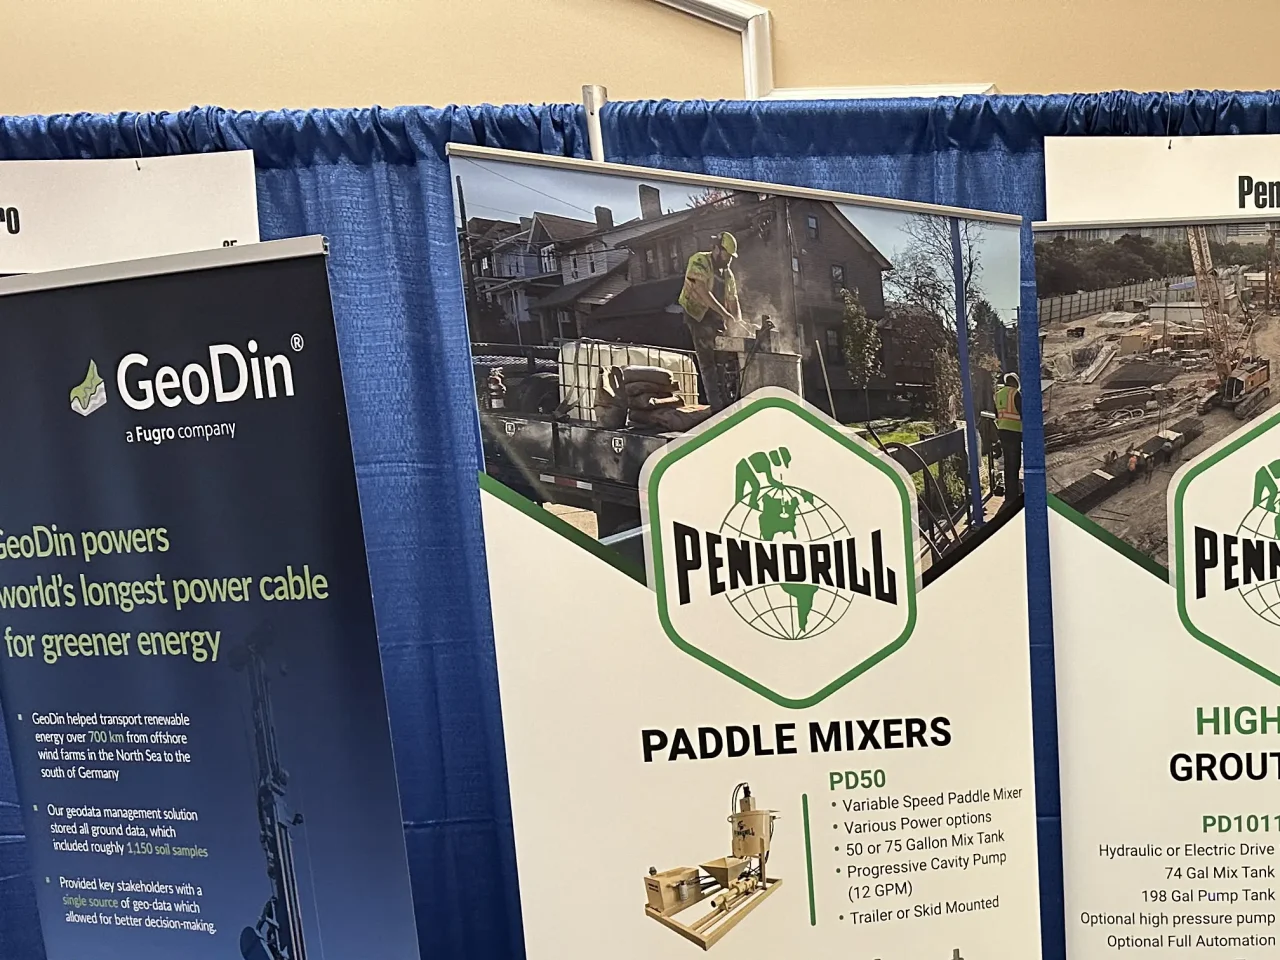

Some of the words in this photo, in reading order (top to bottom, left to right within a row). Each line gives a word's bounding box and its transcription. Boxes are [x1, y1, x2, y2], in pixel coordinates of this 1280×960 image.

[126, 431, 134, 443] a
[135, 426, 175, 445] Fugro
[177, 422, 236, 442] company
[81, 527, 170, 563] powers
[672, 520, 898, 606] PENNDRILL
[0, 573, 76, 609] world's
[79, 573, 168, 613] longest
[172, 576, 253, 611] power
[259, 564, 329, 601] cable
[4, 626, 36, 658] for
[41, 632, 131, 664] greener
[137, 630, 221, 663] energy
[31, 712, 66, 725] GeoDin
[66, 712, 98, 728] helped
[99, 713, 143, 728] transport
[143, 712, 190, 726] renewable
[35, 733, 65, 746] energy
[66, 733, 87, 743] over
[87, 730, 107, 743] 700
[108, 730, 125, 743] km
[126, 730, 149, 744] from
[149, 730, 188, 745] offshore
[641, 722, 798, 763] PADDLE
[809, 716, 952, 753] MIXERS
[829, 769, 887, 791] PD50
[842, 795, 899, 812] Variable
[903, 792, 944, 811] Speed
[948, 789, 990, 805] Paddle
[993, 787, 1022, 801] Mixer
[47, 803, 64, 816] Our
[65, 804, 102, 819] geodata
[103, 808, 163, 821] management
[163, 807, 199, 821] solution
[52, 838, 89, 852] included
[90, 840, 125, 856] roughly
[126, 841, 153, 855] 1,150
[154, 843, 171, 855] soil
[172, 844, 209, 859] samples
[1099, 843, 1162, 860] Hydraulic
[1166, 846, 1181, 857] or
[1184, 843, 1236, 857] Electric
[1240, 843, 1275, 856] Drive
[847, 860, 927, 879] Progressive
[930, 856, 970, 871] Cavity
[973, 852, 1007, 866] Pump
[848, 885, 871, 904] (12
[874, 880, 913, 897] GPM)
[849, 908, 893, 925] Trailer
[896, 908, 910, 920] or
[914, 902, 942, 918] Skid
[945, 895, 999, 914] Mounted
[1080, 911, 1135, 927] Optional
[1139, 912, 1169, 928] high
[1172, 914, 1233, 928] pressure
[1236, 913, 1276, 927] pump
